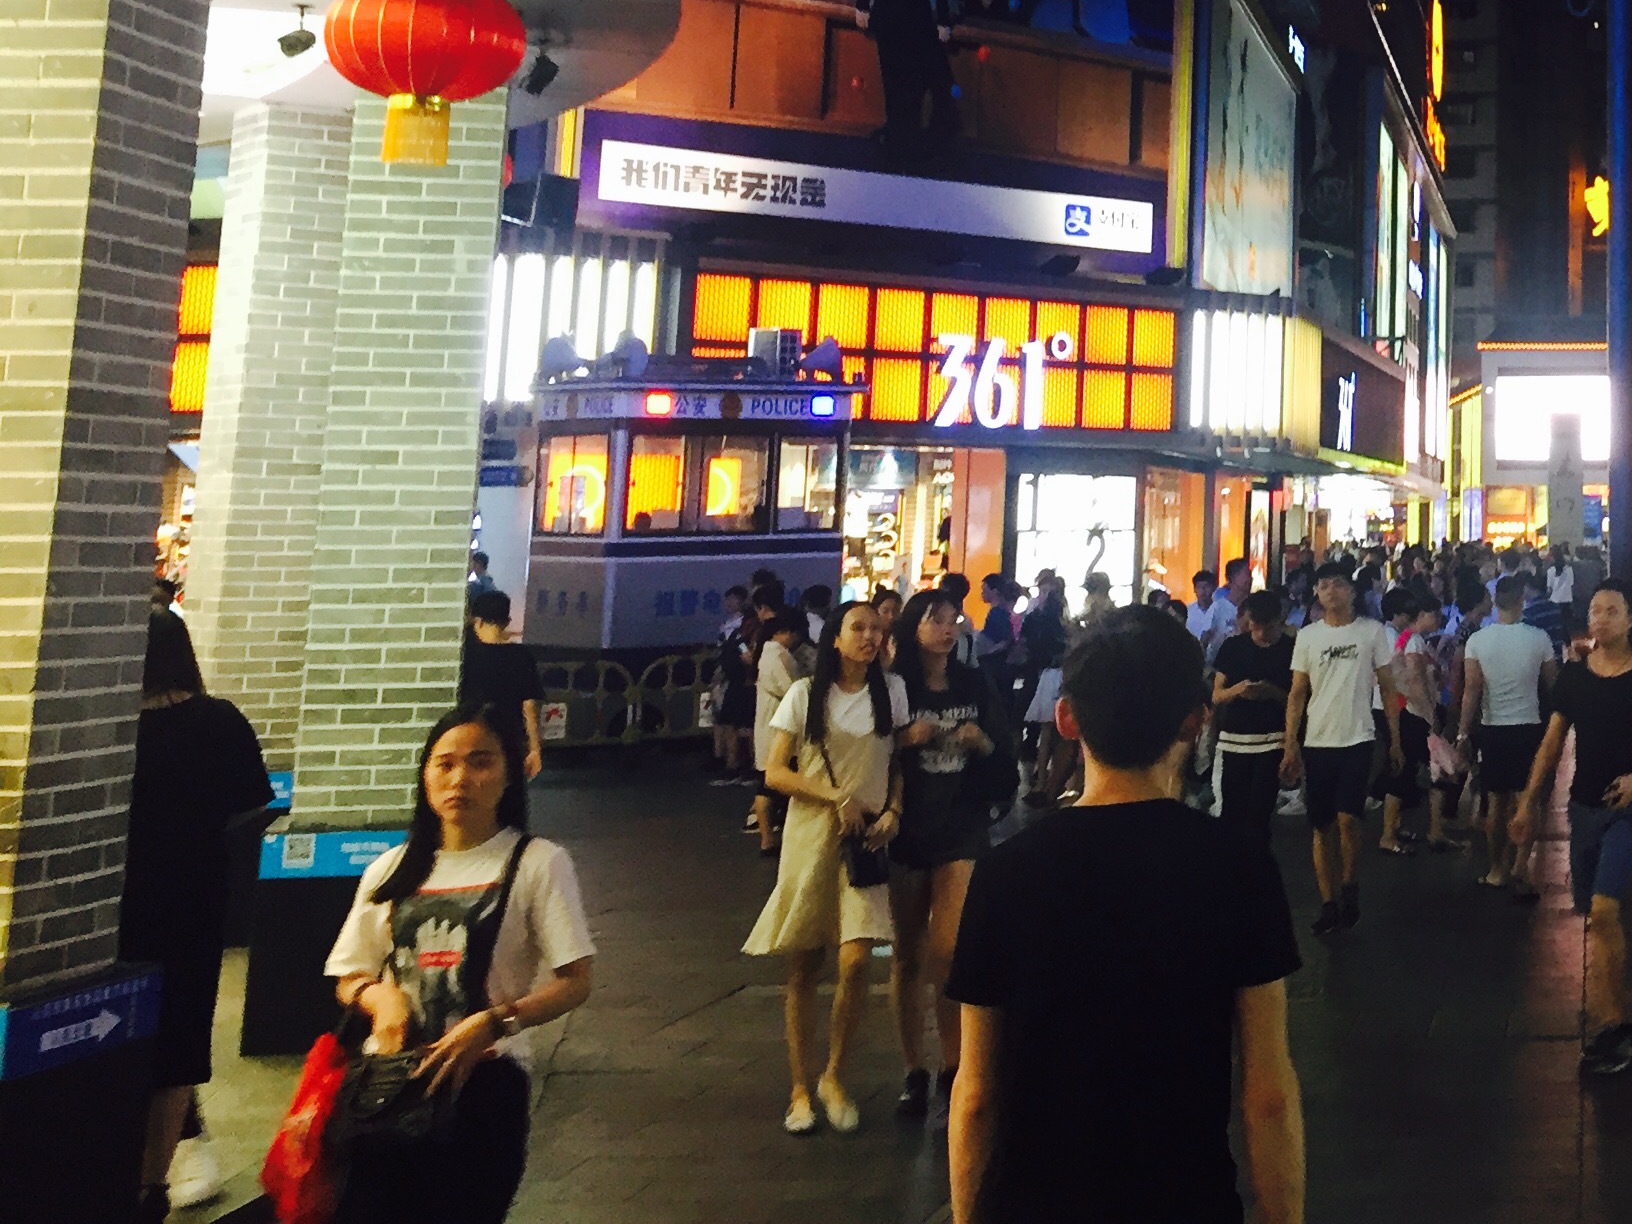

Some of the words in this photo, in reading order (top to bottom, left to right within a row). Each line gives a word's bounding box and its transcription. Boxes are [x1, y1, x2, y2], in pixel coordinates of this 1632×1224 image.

[620, 158, 827, 208] 我们青年无现金
[933, 331, 1074, 431] 361°
[675, 394, 707, 417] 公安
[750, 395, 811, 418] POLICE
